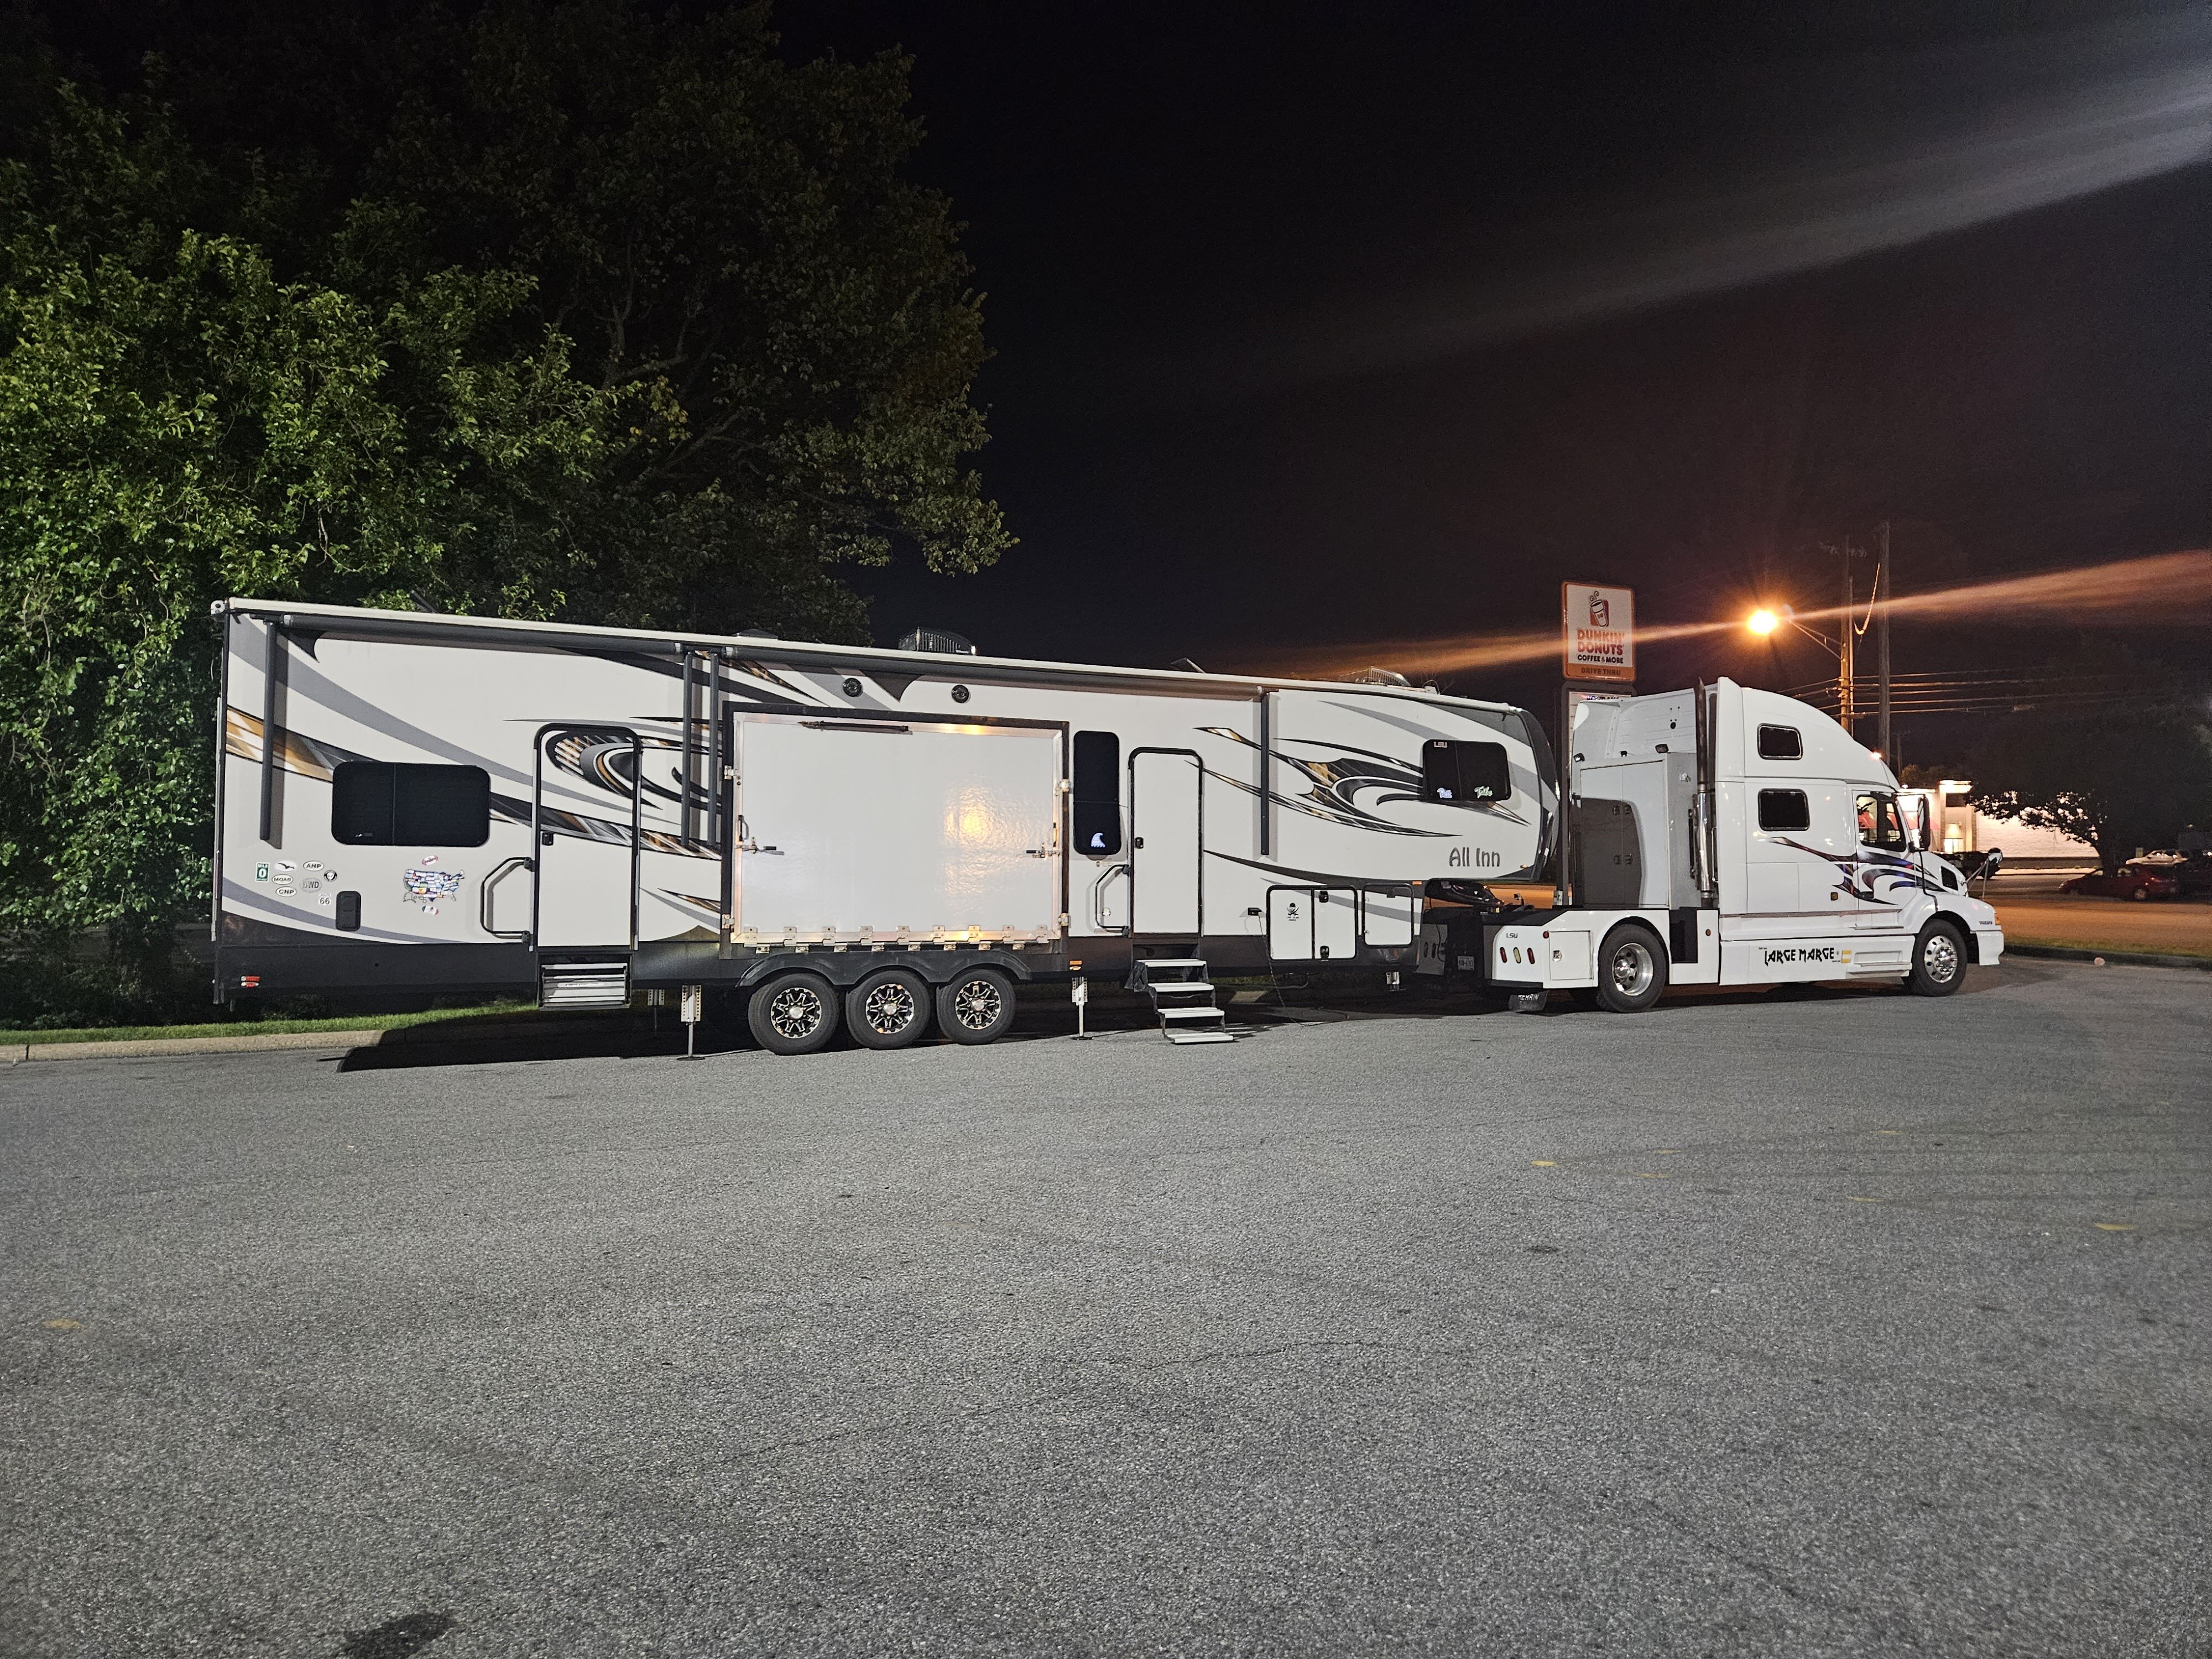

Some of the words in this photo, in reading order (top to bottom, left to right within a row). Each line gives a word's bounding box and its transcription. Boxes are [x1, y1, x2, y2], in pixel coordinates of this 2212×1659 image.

[1577, 629, 1625, 643] DUNKIN'
[1578, 641, 1623, 655] DONUTS
[1449, 847, 1470, 867] All
[1476, 848, 1500, 867] Inn
[1765, 950, 1796, 967] LARGE
[1798, 947, 1834, 963] MARGE
